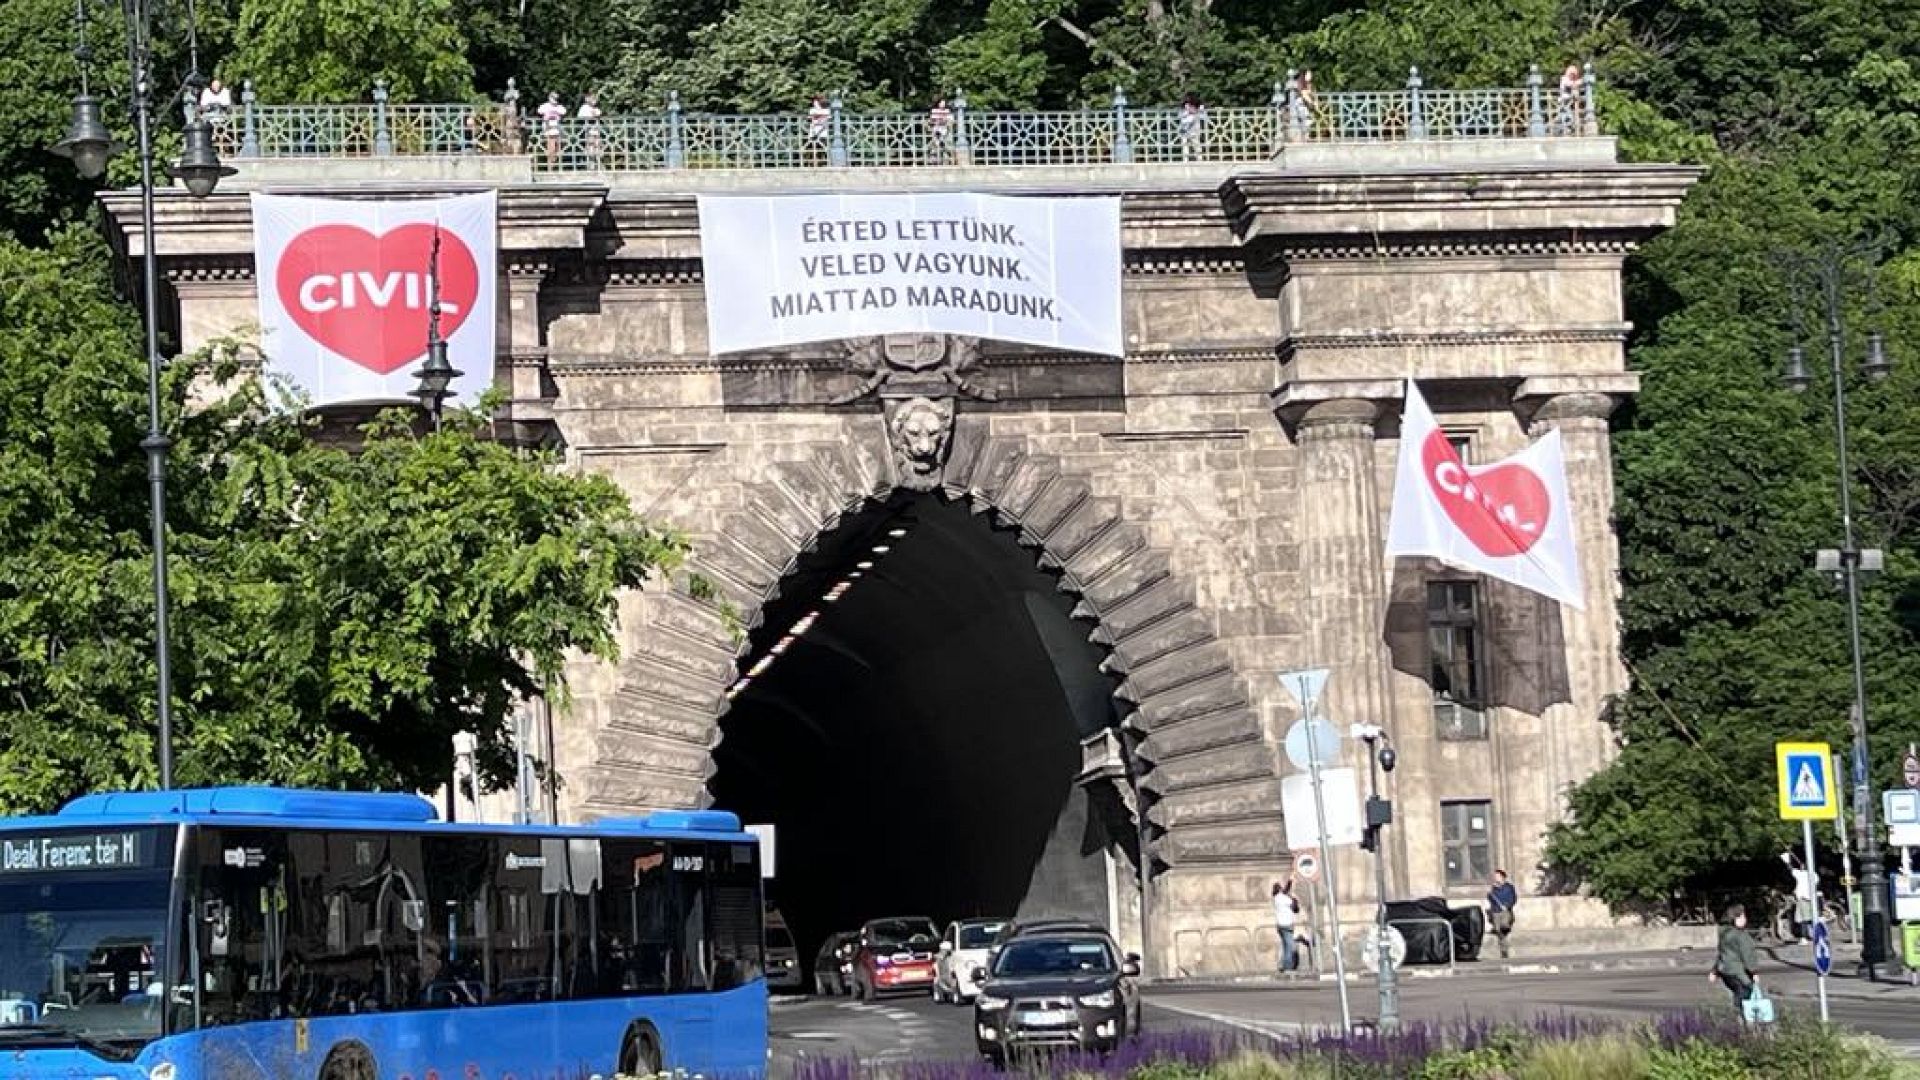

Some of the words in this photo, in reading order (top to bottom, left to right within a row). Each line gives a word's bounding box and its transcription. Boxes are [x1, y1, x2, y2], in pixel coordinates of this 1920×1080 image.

[802, 217, 887, 243] ÉRTED
[896, 217, 1025, 247] LETTÜNK.
[800, 253, 886, 278] VELED
[894, 252, 1030, 282] VAGYUNK.
[299, 271, 459, 315] CIVIL
[770, 286, 897, 318] MIATTAD
[906, 286, 1062, 322] MARADUNK.
[3, 840, 39, 869] Deák
[42, 838, 92, 868] Ferenc
[95, 835, 119, 864] tér
